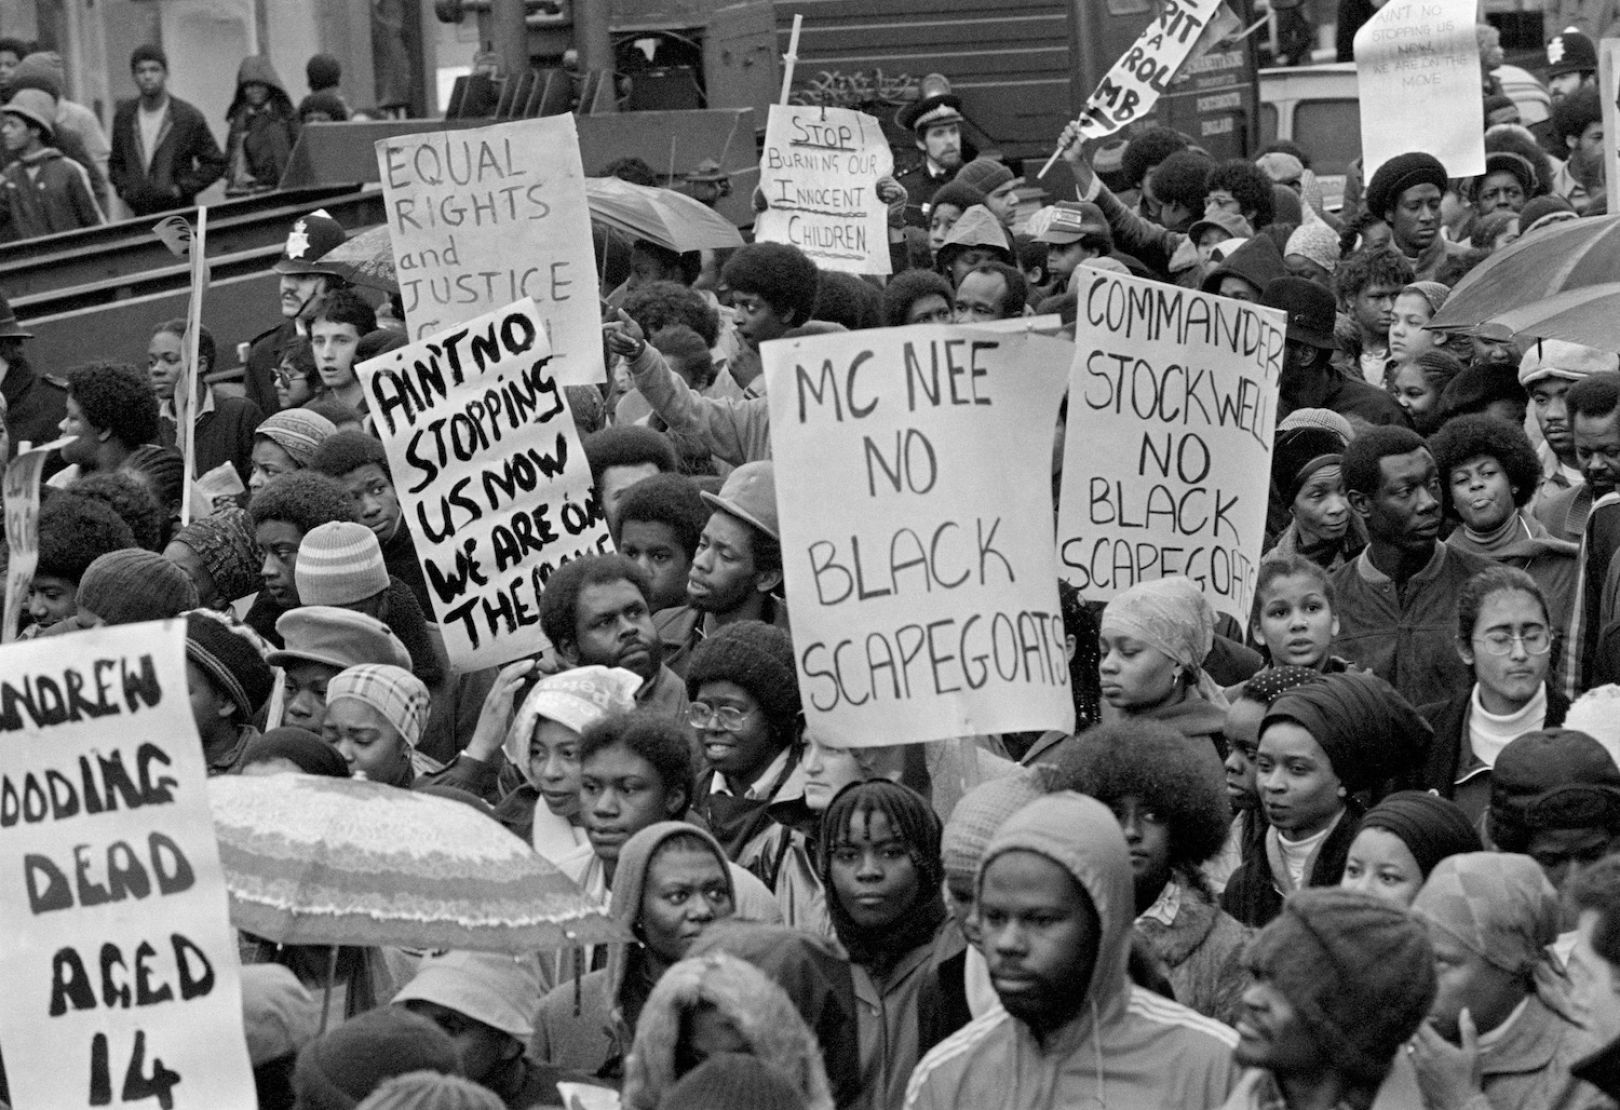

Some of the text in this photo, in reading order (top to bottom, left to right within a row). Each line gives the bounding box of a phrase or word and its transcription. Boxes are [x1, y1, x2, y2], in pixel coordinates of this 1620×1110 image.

[1421, 5, 1442, 17] NO
[1436, 21, 1455, 33] US
[1402, 72, 1441, 88] MOVE
[385, 138, 528, 190] EQUAL
[773, 178, 866, 208] INNOCENT
[848, 154, 878, 175] OUR
[394, 184, 551, 236] RIGHTS
[400, 234, 462, 271] and
[402, 261, 573, 313] JUSTICE
[470, 312, 537, 375] NO
[1087, 276, 1284, 388] COMMANDER
[795, 339, 999, 424] MC NEE
[1085, 350, 1269, 453] STOCKWELL
[416, 431, 568, 544] US NOW
[862, 427, 938, 497] NO
[1138, 431, 1211, 485] NO
[1089, 476, 1241, 546] BLACK
[425, 537, 488, 604] WE
[491, 503, 559, 573] ARE
[808, 517, 1015, 606] BLACK
[443, 576, 540, 651] THE
[0, 654, 162, 733] NDREW
[801, 610, 1068, 712] SCAPEGOATS
[0, 742, 178, 828] OODING
[24, 831, 196, 915] DEAD
[48, 932, 216, 1018] AGED
[88, 1029, 182, 1110] 14
